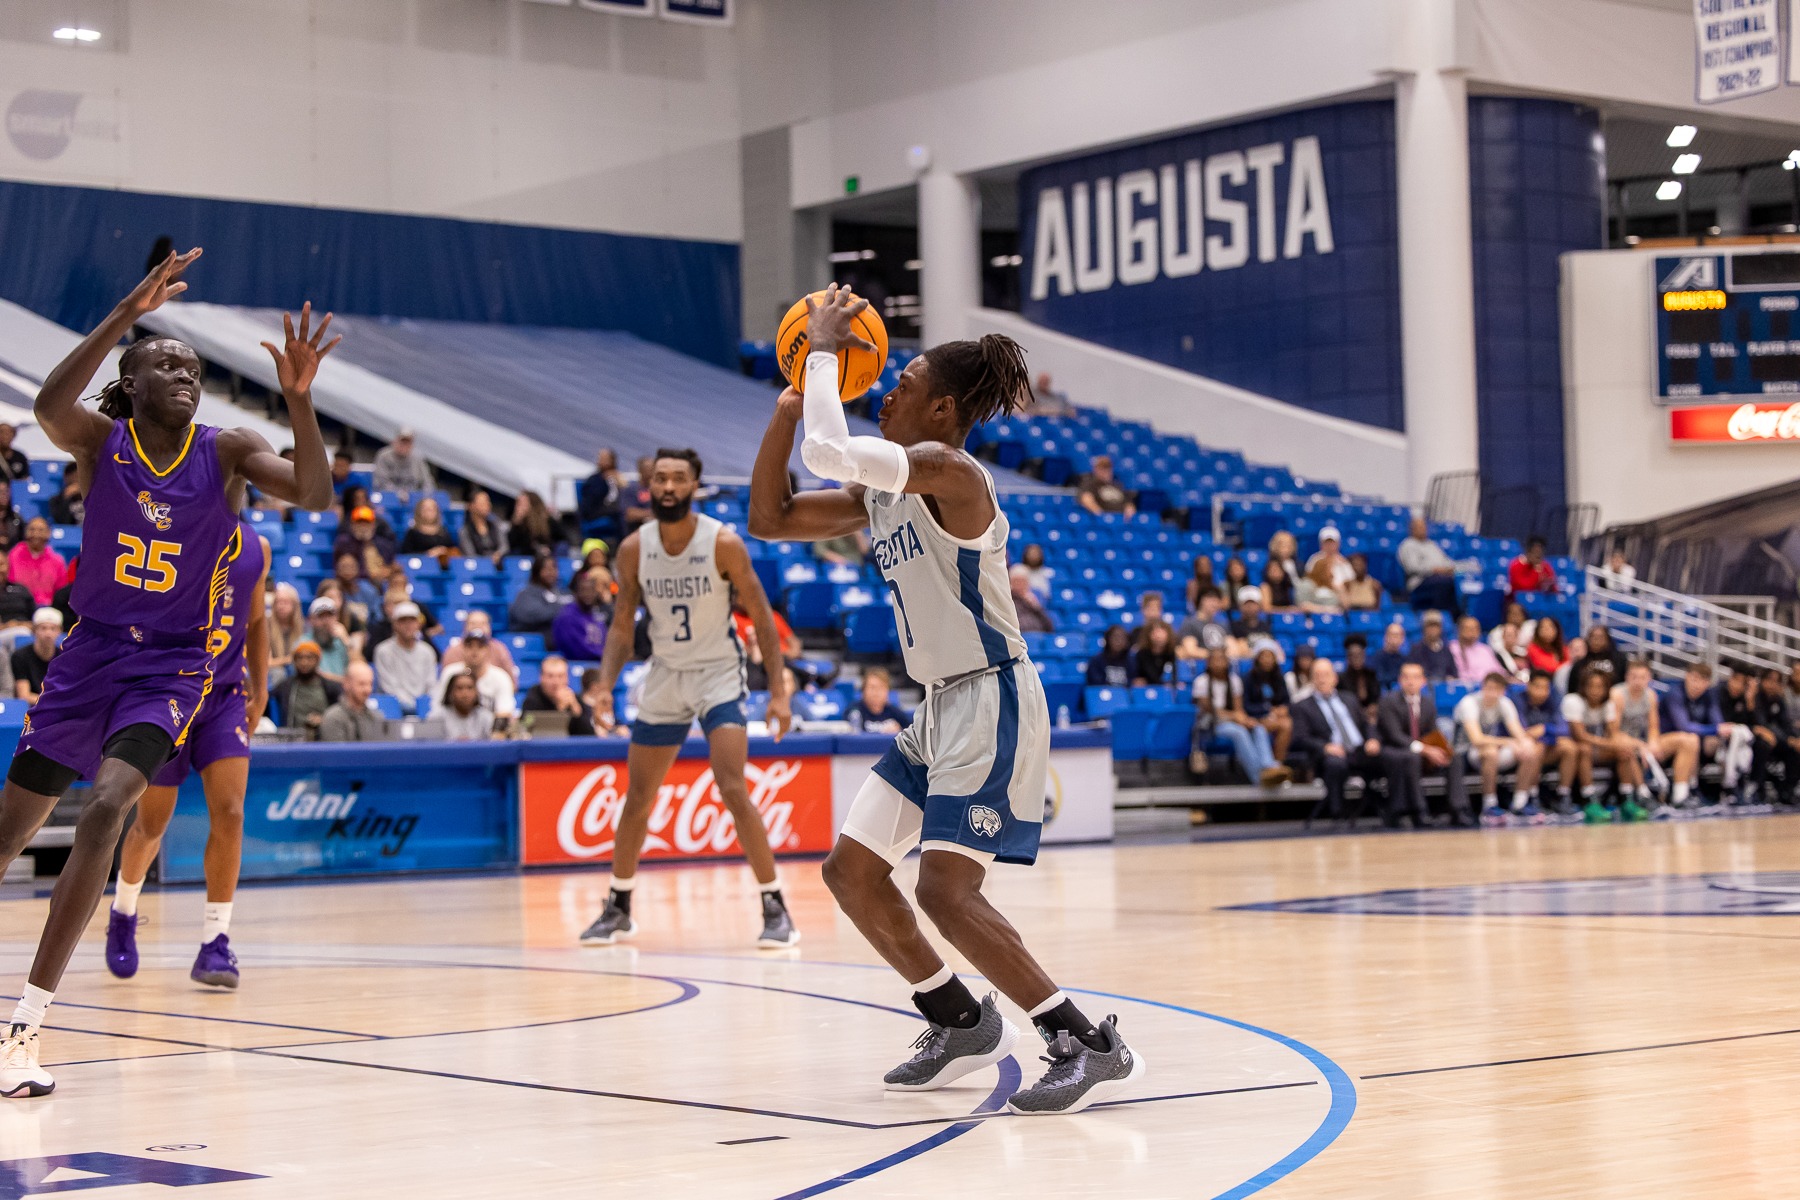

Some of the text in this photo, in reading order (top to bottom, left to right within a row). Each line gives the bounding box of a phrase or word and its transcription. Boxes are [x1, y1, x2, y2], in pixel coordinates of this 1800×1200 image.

[1030, 135, 1334, 301] AUGUSTA
[114, 532, 182, 593] 25
[645, 575, 712, 599] AUGUSTA
[671, 605, 691, 641] 3
[266, 779, 362, 821] Jani
